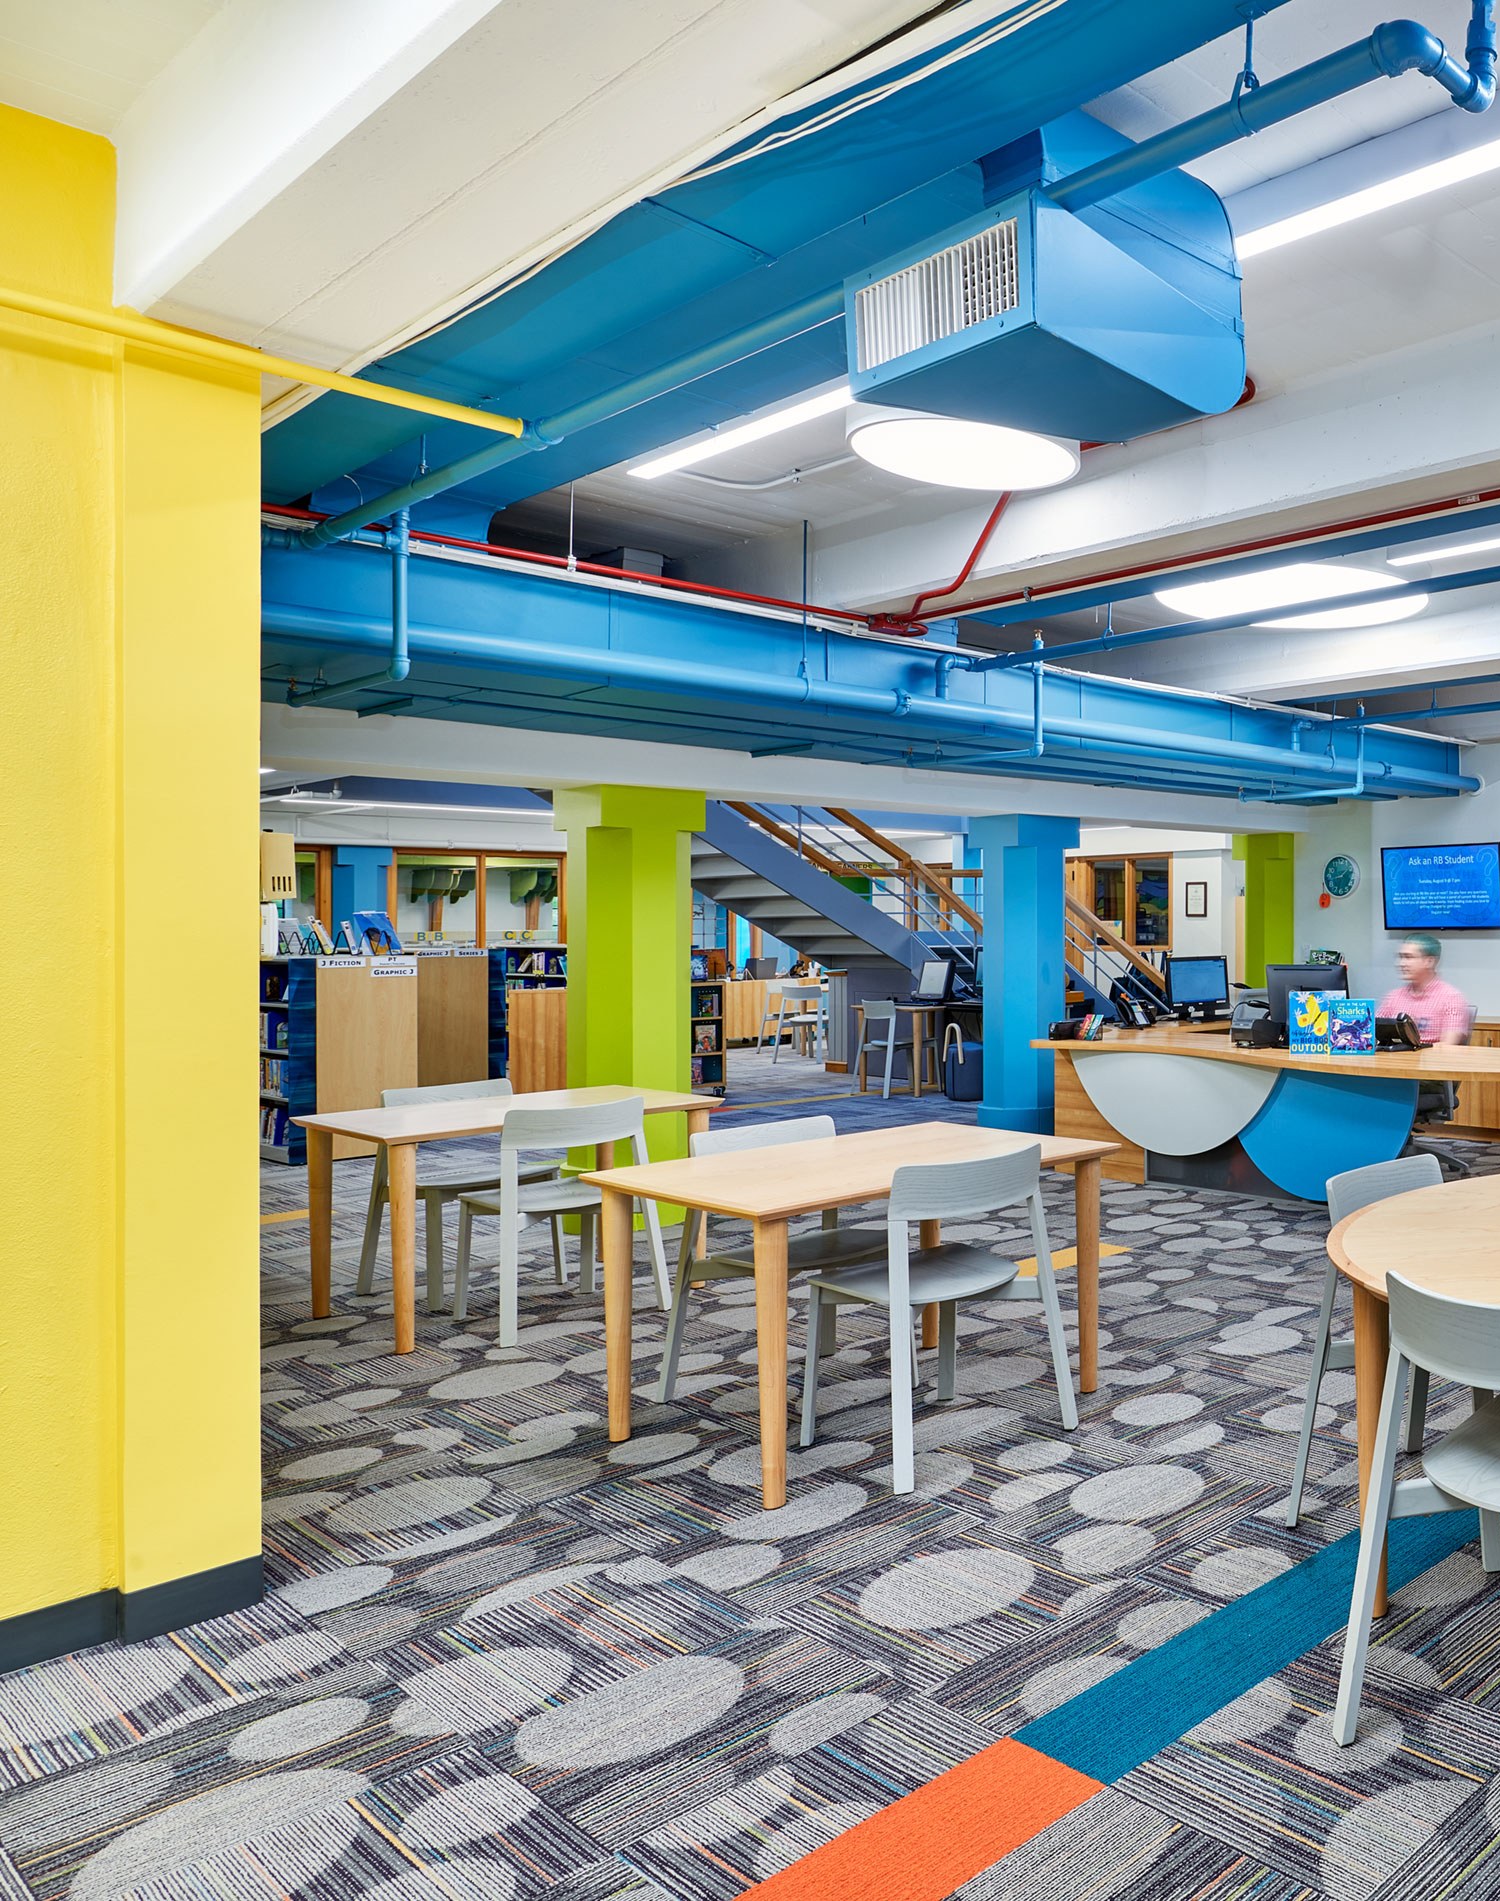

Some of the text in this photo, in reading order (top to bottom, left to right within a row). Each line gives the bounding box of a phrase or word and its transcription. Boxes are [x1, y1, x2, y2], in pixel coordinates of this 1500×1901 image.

[1408, 857, 1422, 866] Ask
[1433, 855, 1444, 865] RB
[1445, 854, 1474, 864] Student
[417, 931, 443, 941] B B
[504, 930, 531, 940] C C
[329, 959, 362, 967] FICTION
[1337, 1006, 1365, 1015] Sharks
